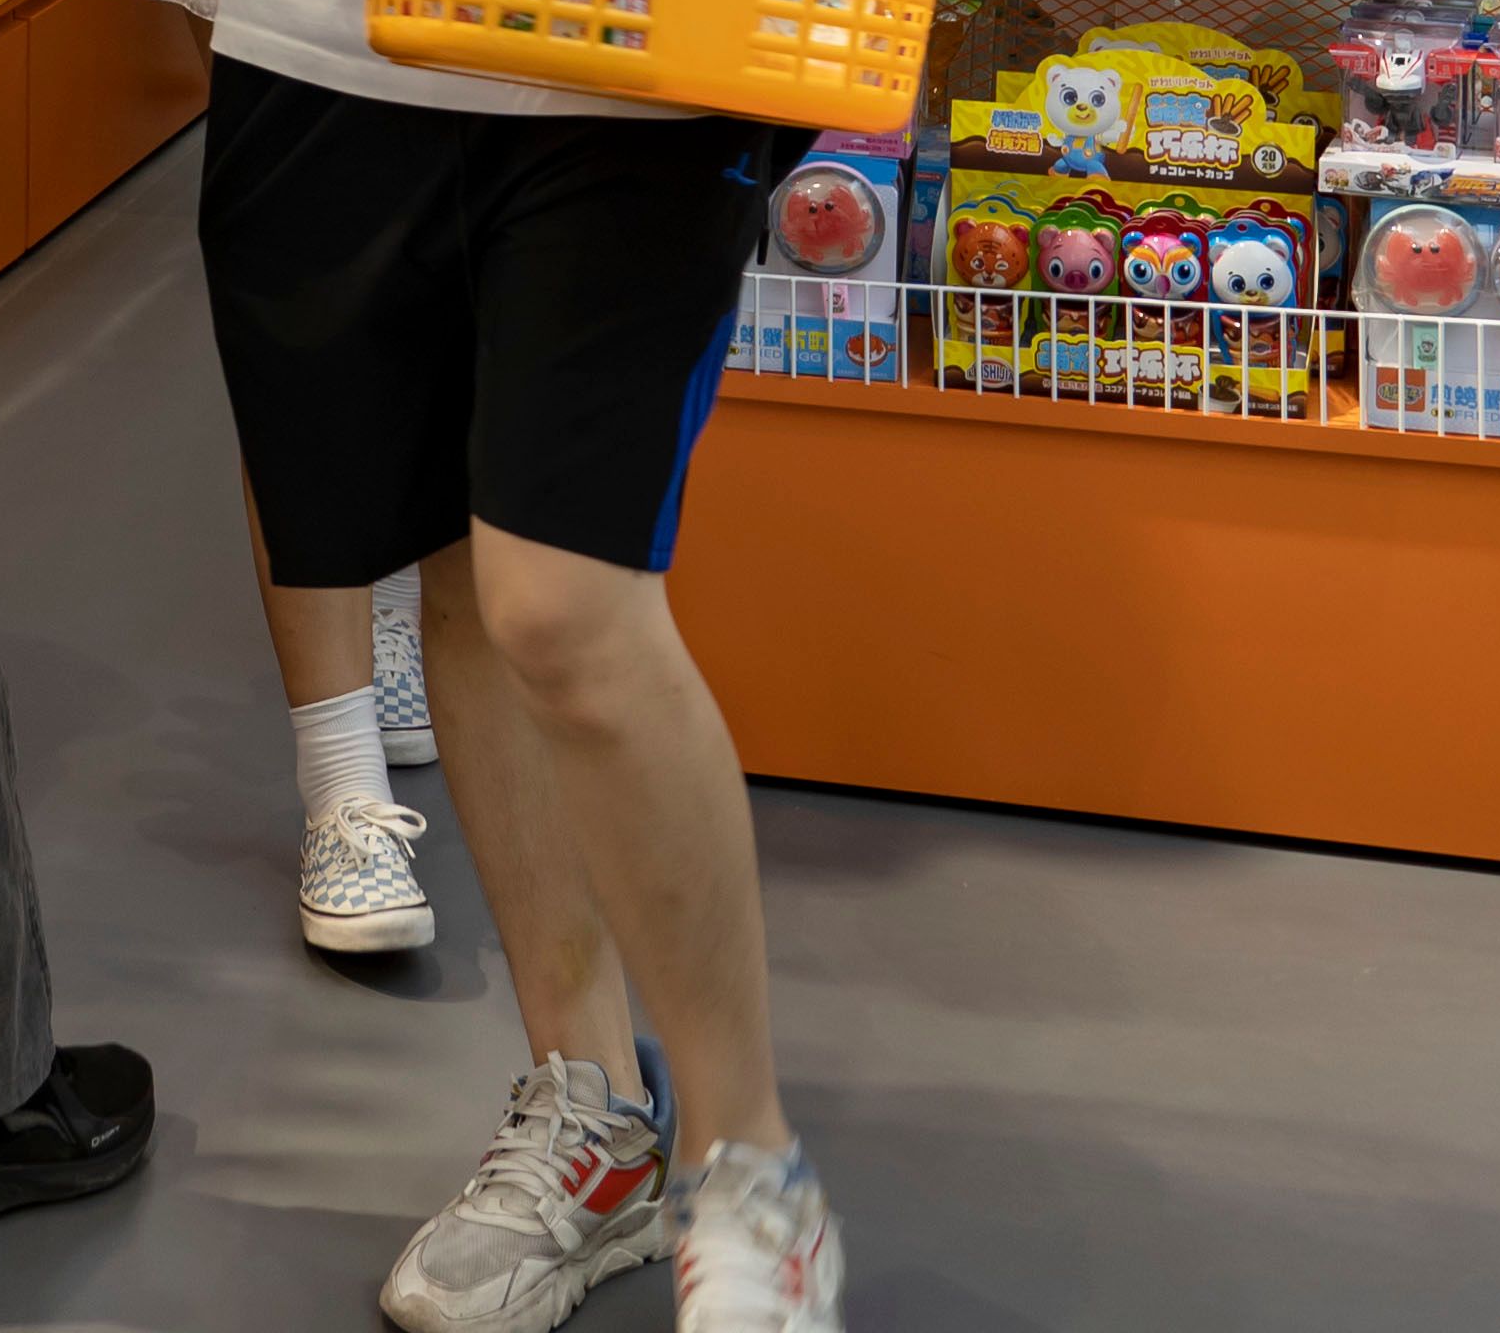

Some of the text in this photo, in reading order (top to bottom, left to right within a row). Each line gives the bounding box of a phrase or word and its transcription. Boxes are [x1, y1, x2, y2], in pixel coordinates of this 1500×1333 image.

[1261, 150, 1277, 162] 20
[1150, 165, 1235, 181] チョコレートカップ
